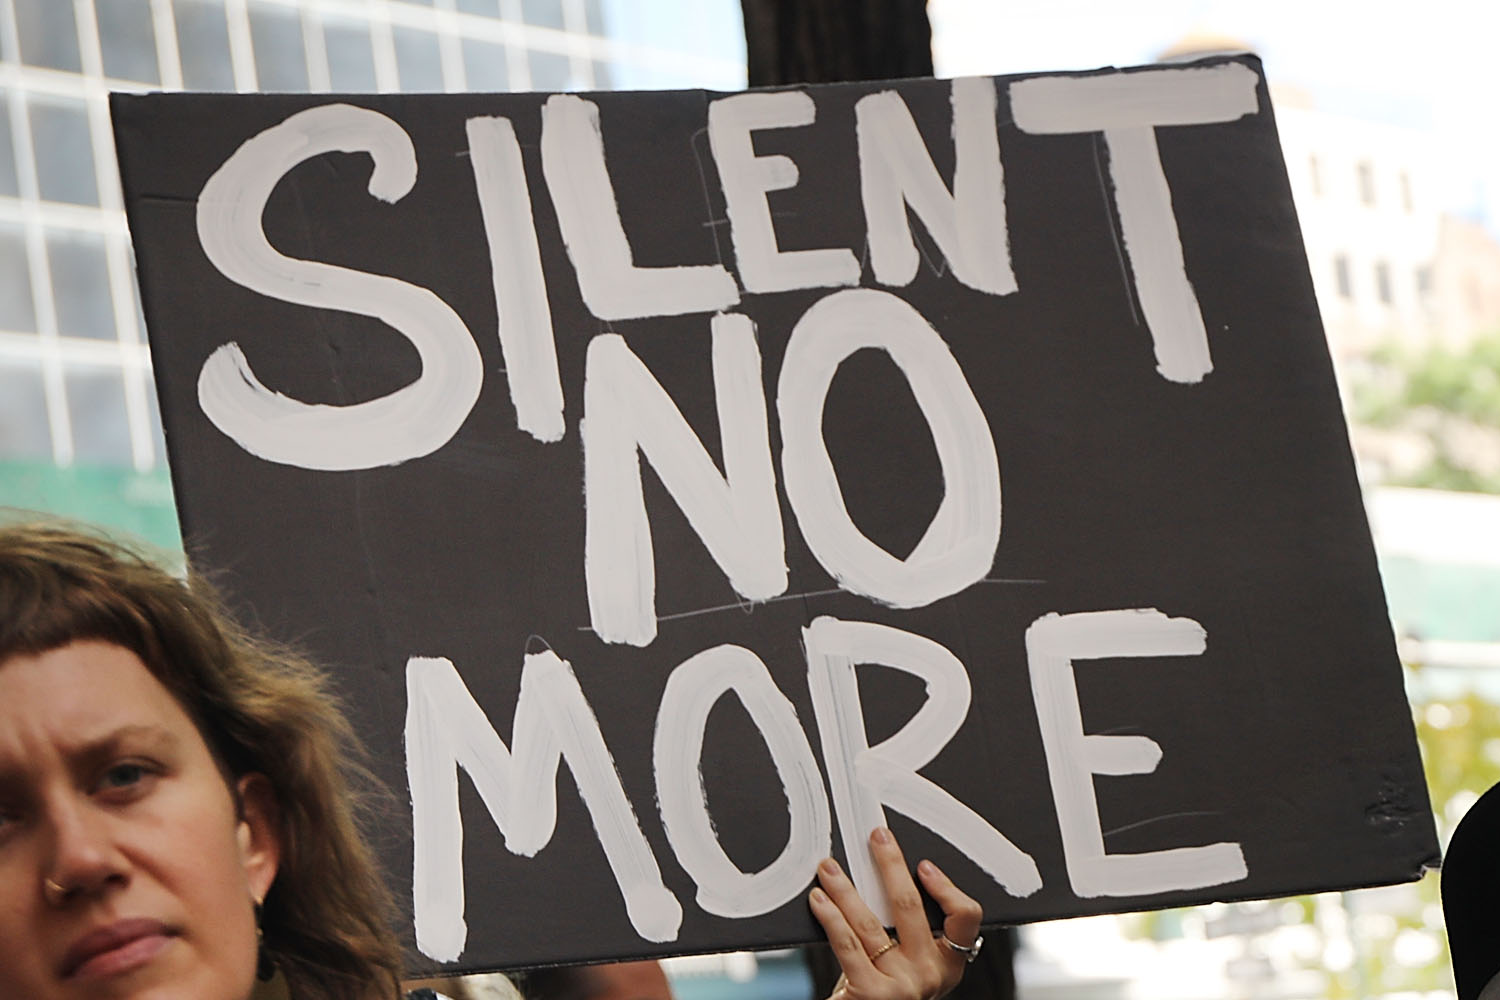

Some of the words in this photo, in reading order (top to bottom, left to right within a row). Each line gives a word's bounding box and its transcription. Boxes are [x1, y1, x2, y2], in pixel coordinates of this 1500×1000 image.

[196, 64, 1258, 471] SILENT
[583, 288, 1001, 646] NO
[404, 609, 1247, 963] MORE
